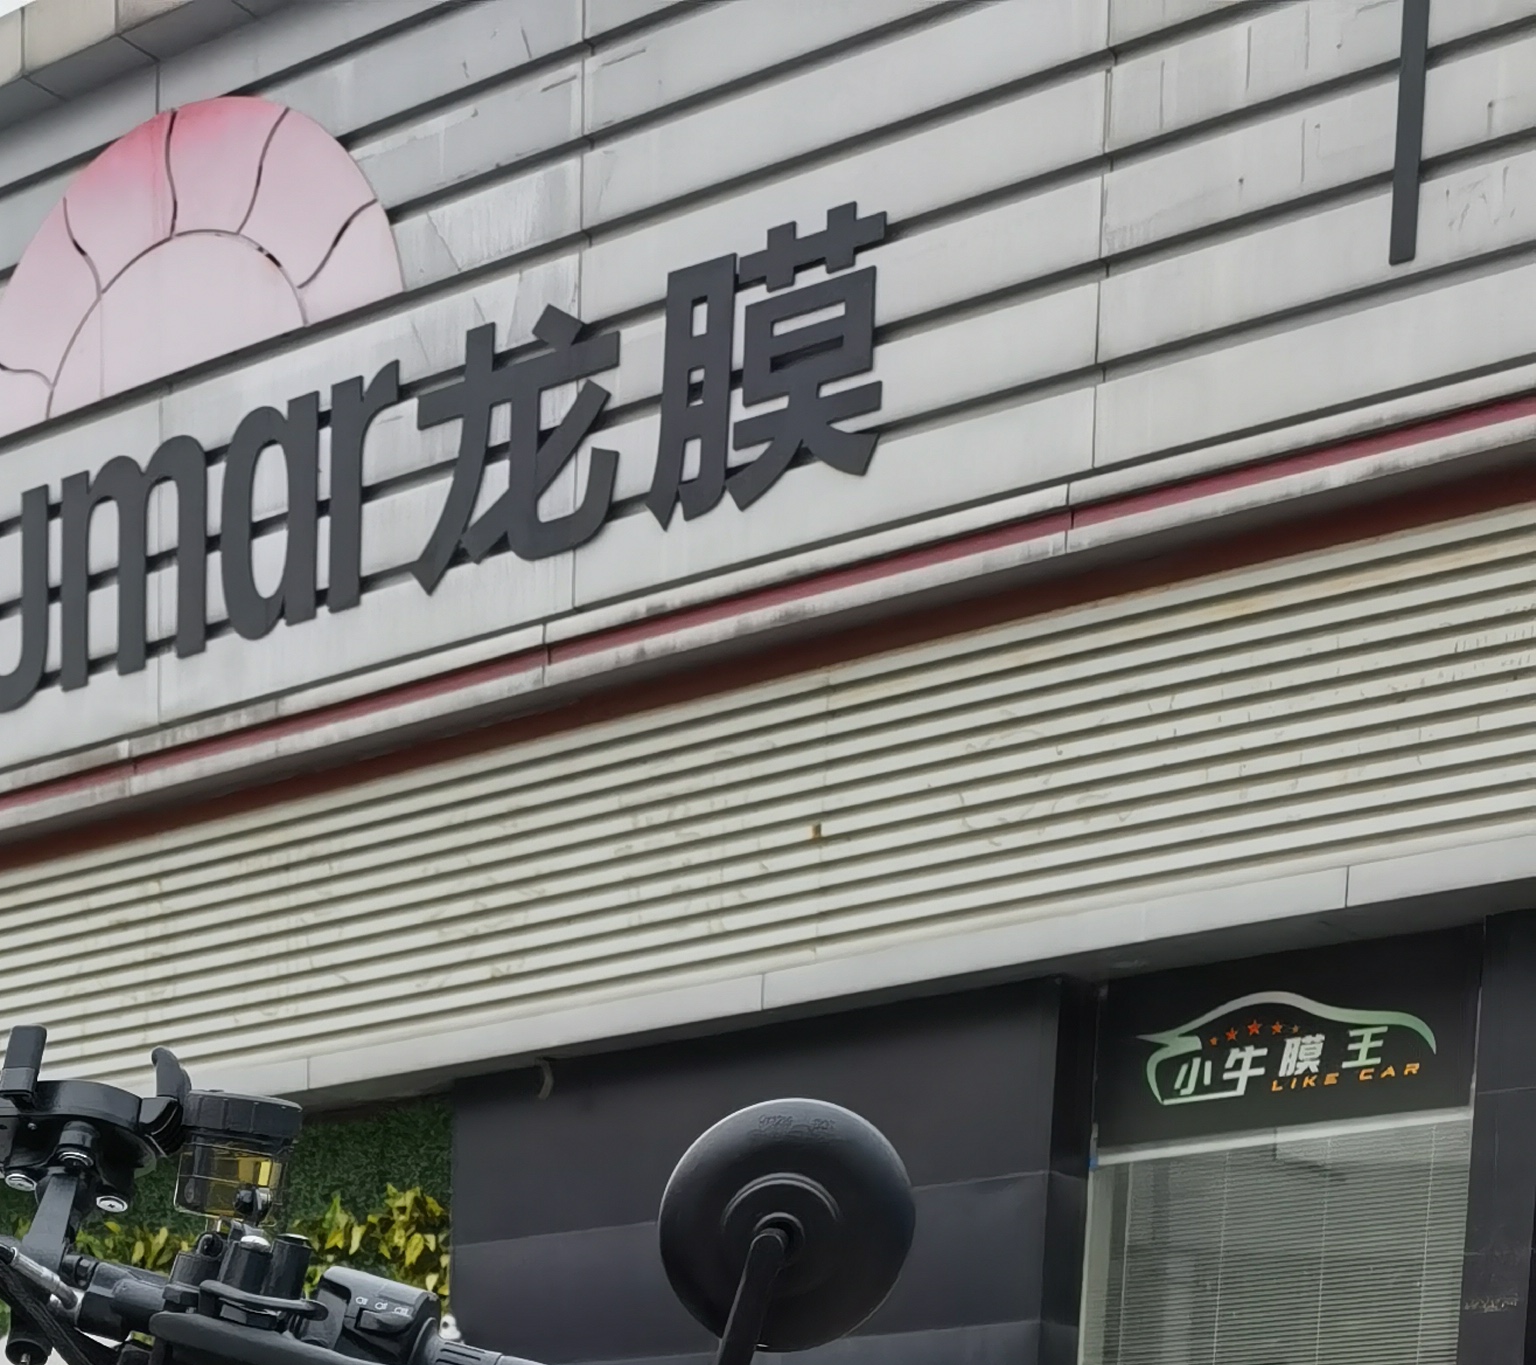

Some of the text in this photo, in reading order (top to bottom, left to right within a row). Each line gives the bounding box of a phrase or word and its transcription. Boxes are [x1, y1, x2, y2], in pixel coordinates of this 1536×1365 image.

[410, 200, 887, 596] 龙膜
[1173, 1026, 1389, 1096] 小牛膜王
[1271, 1062, 1420, 1092] LIKE CAR
